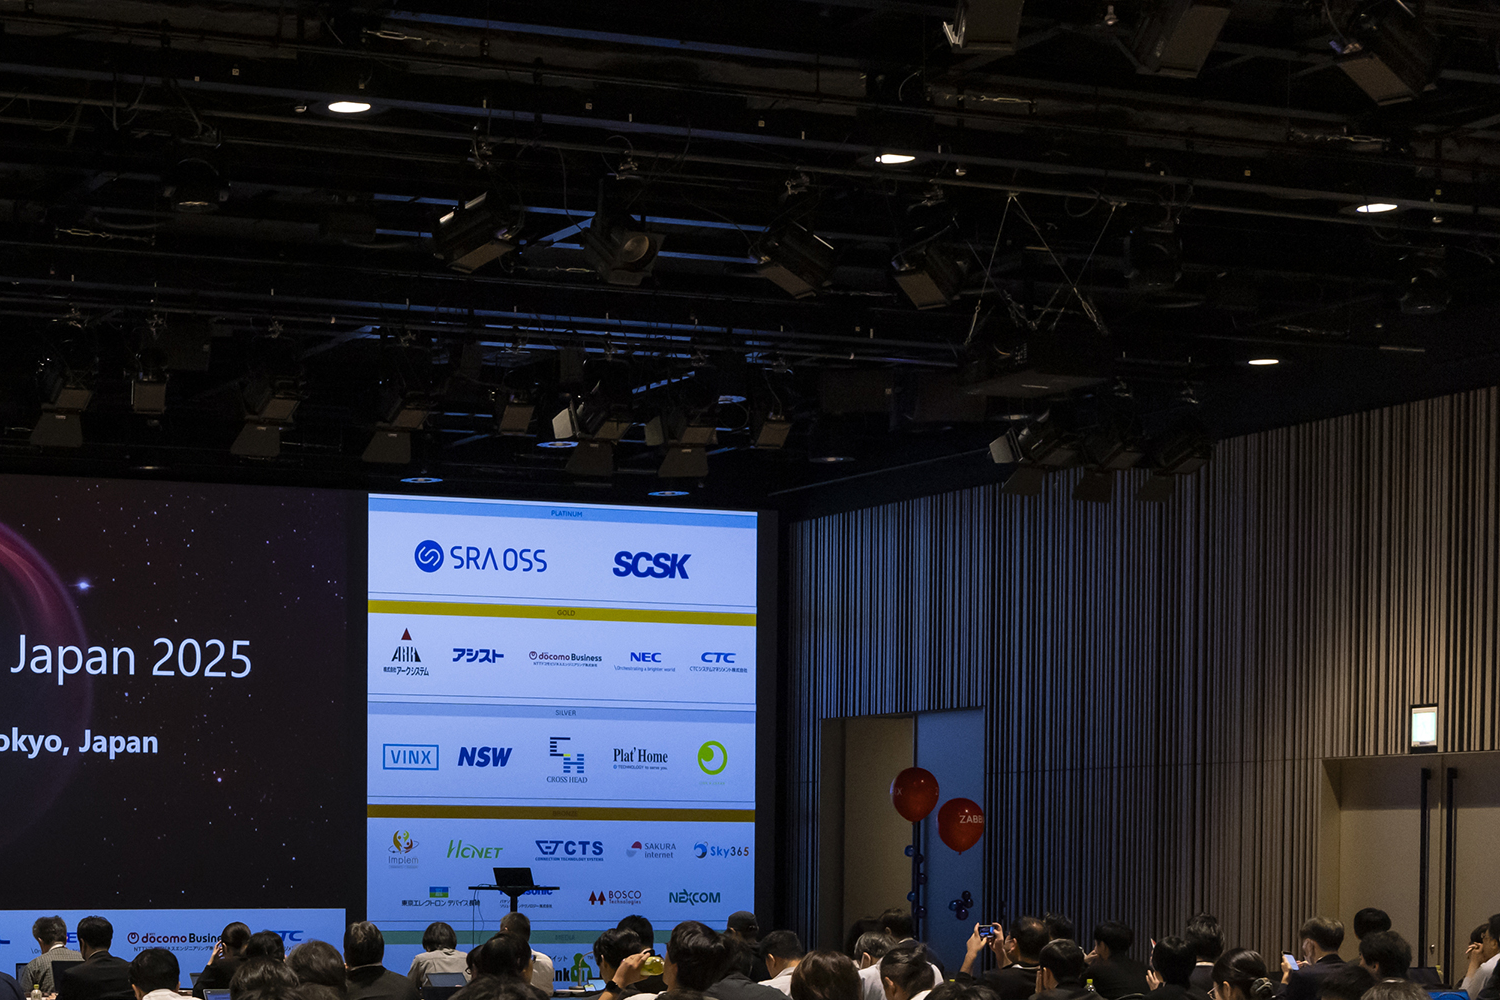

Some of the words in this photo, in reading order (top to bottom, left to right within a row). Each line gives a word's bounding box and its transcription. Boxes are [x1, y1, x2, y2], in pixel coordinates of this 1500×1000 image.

[550, 510, 583, 518] PLATINUM
[502, 548, 547, 572] OSS
[613, 551, 692, 579] SCSK
[557, 609, 575, 617] GOLD
[10, 634, 136, 685] Japan
[152, 638, 253, 678] 2025
[452, 648, 504, 664] アシスト
[538, 651, 570, 662] docomo
[571, 653, 602, 663] Business
[630, 651, 662, 663] NEC
[701, 651, 736, 664] CTC
[79, 729, 159, 760] Japan
[390, 749, 432, 765] VINX
[457, 746, 512, 767] NSW
[569, 776, 588, 784] HEAD
[564, 840, 604, 856] CTS
[644, 843, 676, 851] SAKURA
[710, 846, 750, 858] Sky365
[388, 856, 419, 865] Implem
[644, 851, 674, 859] internet
[608, 890, 641, 899] BOSCO
[669, 889, 721, 906] NEXCOM
[141, 932, 187, 944] docomo
